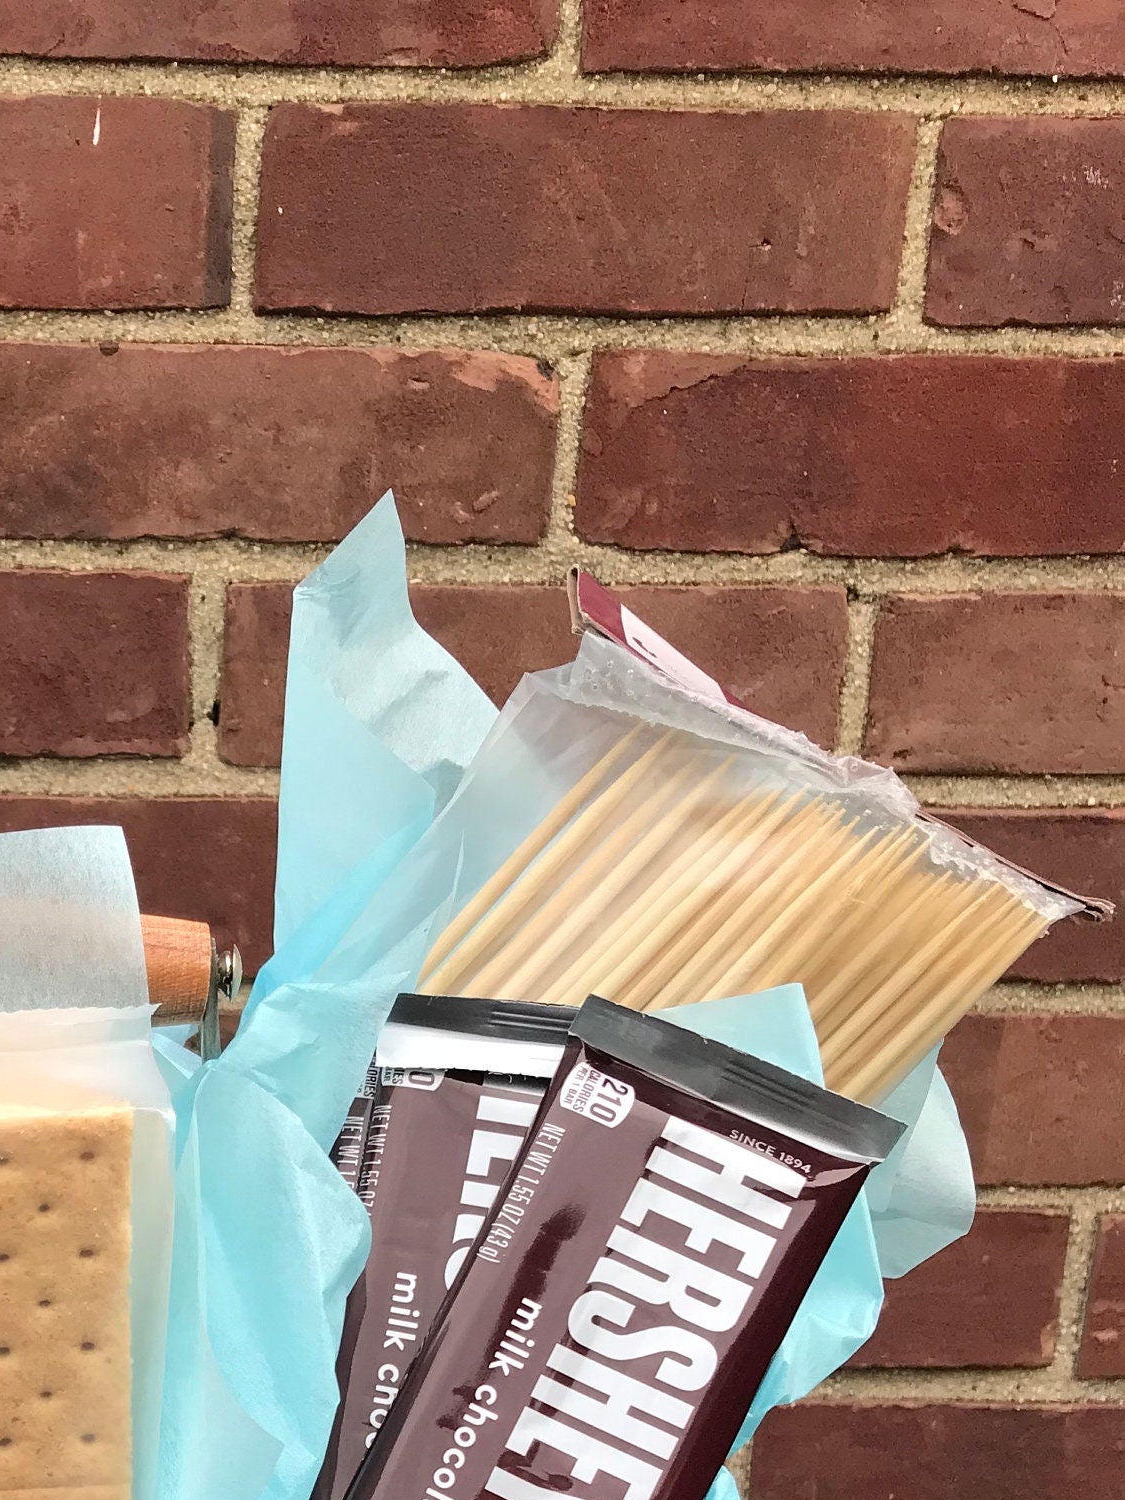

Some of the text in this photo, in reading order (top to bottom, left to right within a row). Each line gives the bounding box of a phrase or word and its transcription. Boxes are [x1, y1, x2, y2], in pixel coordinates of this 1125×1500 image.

[572, 1070, 601, 1113] CALORIES
[575, 1067, 589, 1082] PER
[563, 1088, 578, 1105] BAR
[590, 1078, 628, 1123] 210
[341, 1116, 364, 1142] NET
[371, 1105, 392, 1130] NET
[336, 1145, 360, 1166] WT
[366, 1133, 386, 1155] WT
[729, 1129, 812, 1174] SINCE 1894
[477, 1123, 565, 1263] NET WT 1.55 OZ (43 g)
[383, 1272, 421, 1351] milk
[489, 1297, 543, 1377] milk
